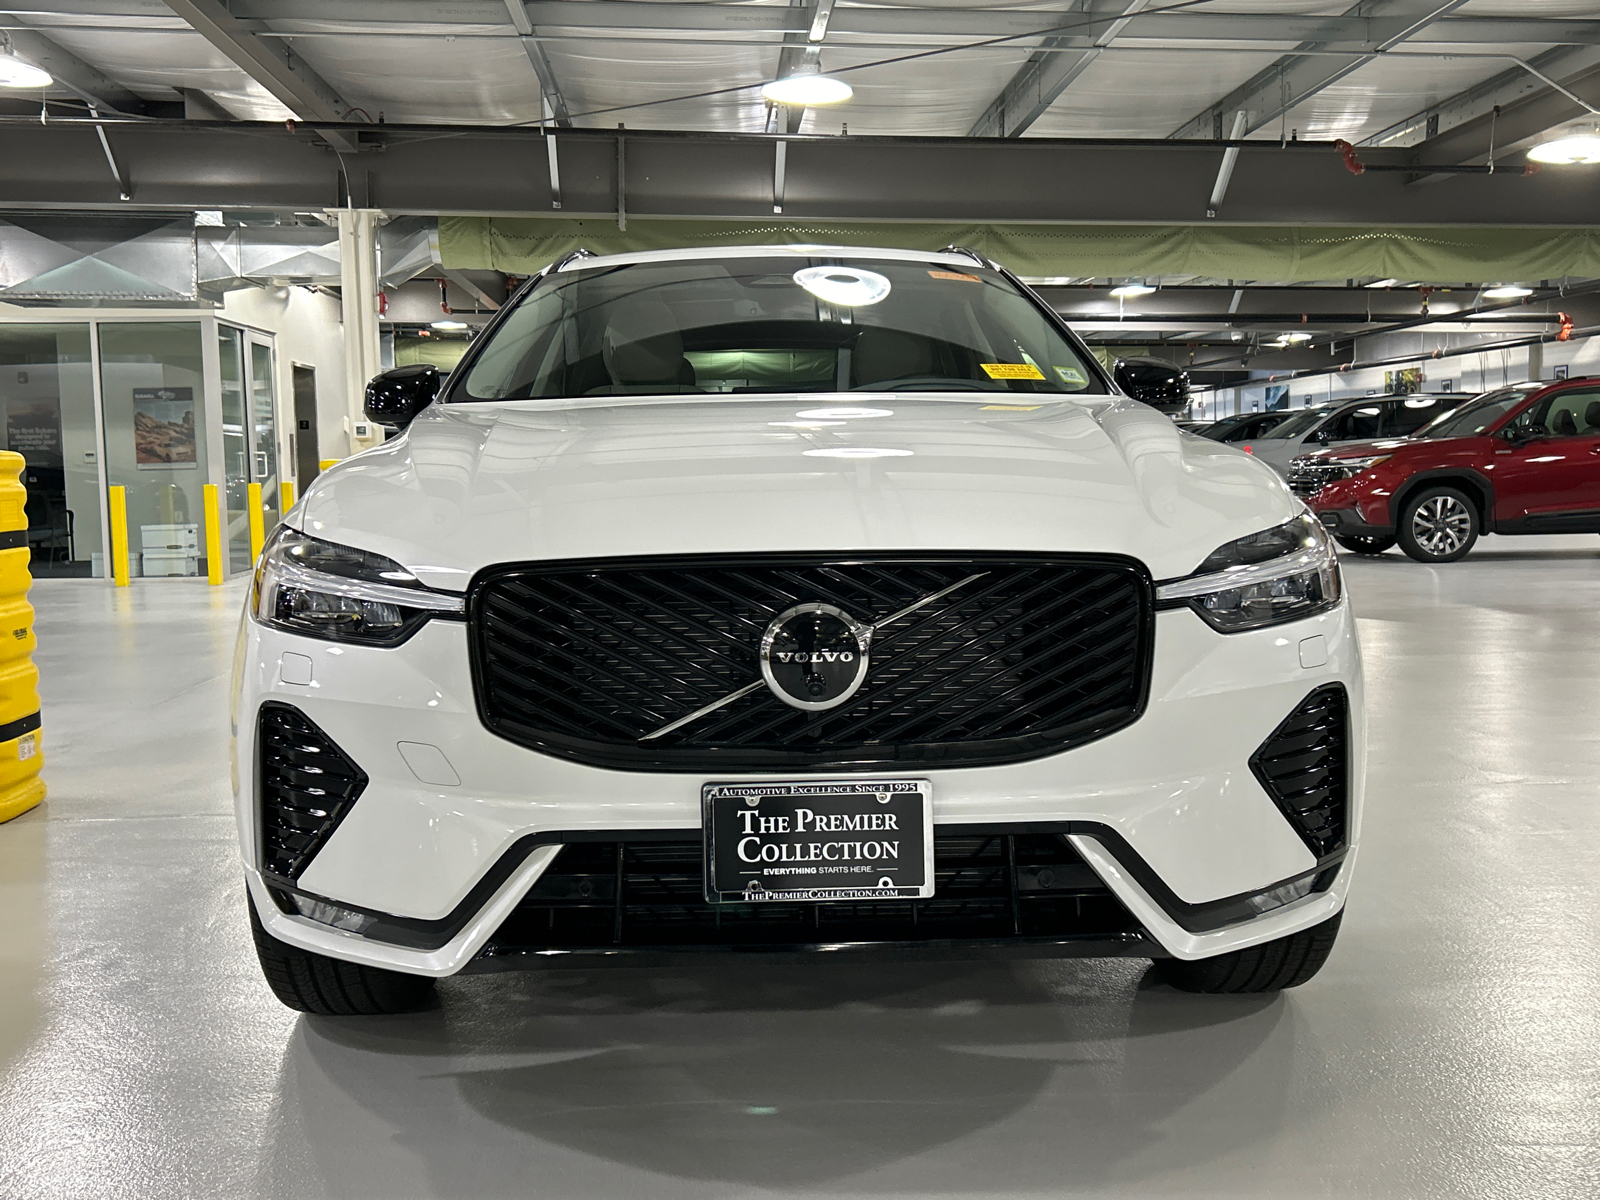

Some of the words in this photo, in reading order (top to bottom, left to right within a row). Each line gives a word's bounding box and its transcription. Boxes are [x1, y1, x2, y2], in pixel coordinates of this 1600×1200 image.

[776, 651, 854, 663] VOLVO
[721, 786, 788, 796] AUTOMOTIVE
[790, 785, 852, 795] EXCELLENCE
[855, 784, 886, 793] SINCE
[889, 783, 916, 792] 1995
[737, 809, 790, 834] THE
[794, 808, 899, 832] PREMIER
[737, 836, 899, 863] COLLECTION
[763, 867, 817, 876] EVERYTHING
[818, 866, 850, 875] STARTS
[851, 865, 875, 873] HERE.
[741, 889, 899, 900] THEPREMIERCOLLECTION.COM
